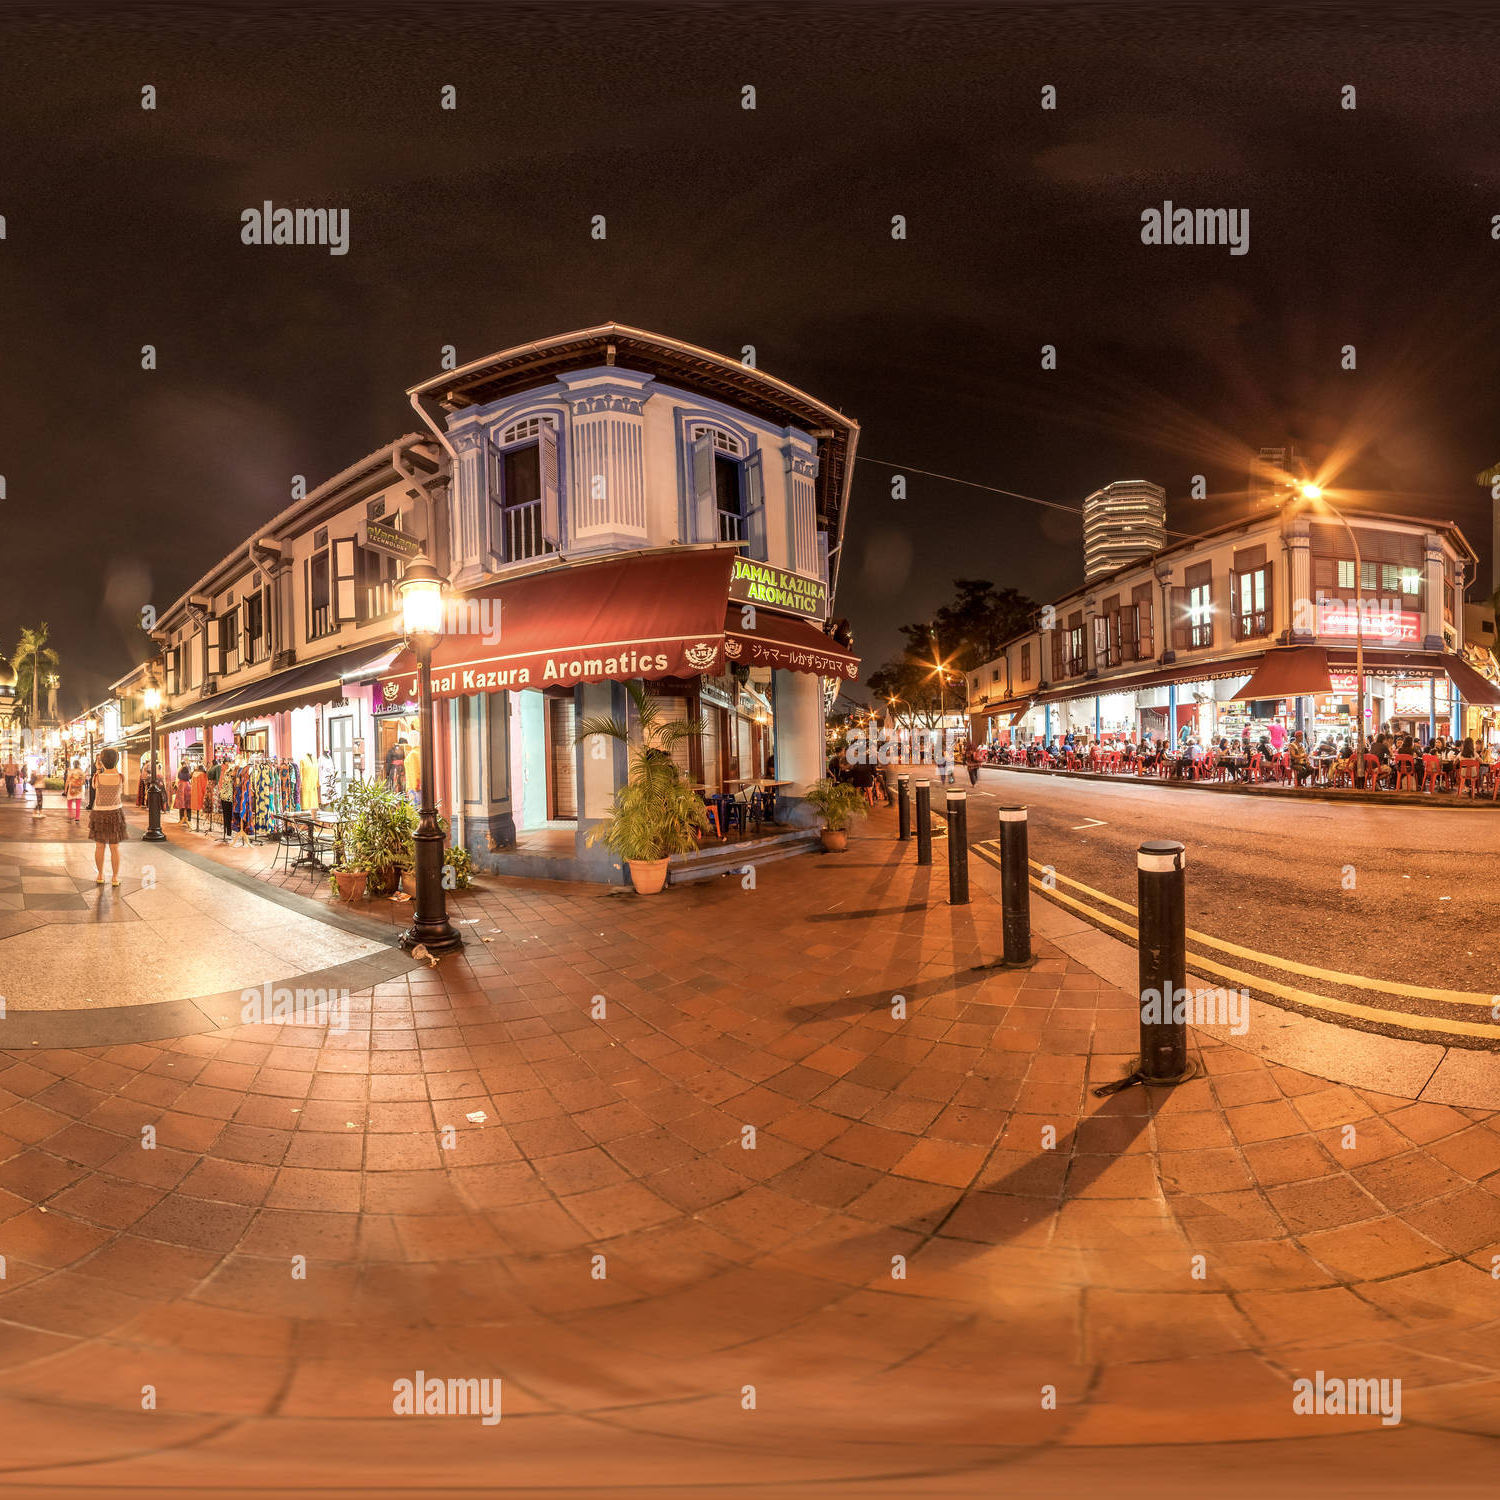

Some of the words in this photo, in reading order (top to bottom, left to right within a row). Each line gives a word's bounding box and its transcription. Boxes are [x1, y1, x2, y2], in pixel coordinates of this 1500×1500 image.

[735, 561, 778, 587] JAMAL
[780, 573, 825, 600] KAZURA
[748, 582, 817, 613] AROMATICS
[751, 644, 843, 672] ジャマールかずらアロマ
[1328, 668, 1374, 676] AMPOG
[409, 672, 456, 696] Jmal
[463, 667, 530, 689] Kazura
[543, 650, 668, 681] Aromatics
[1210, 672, 1233, 680] GLAM
[1234, 669, 1257, 677] CAFE
